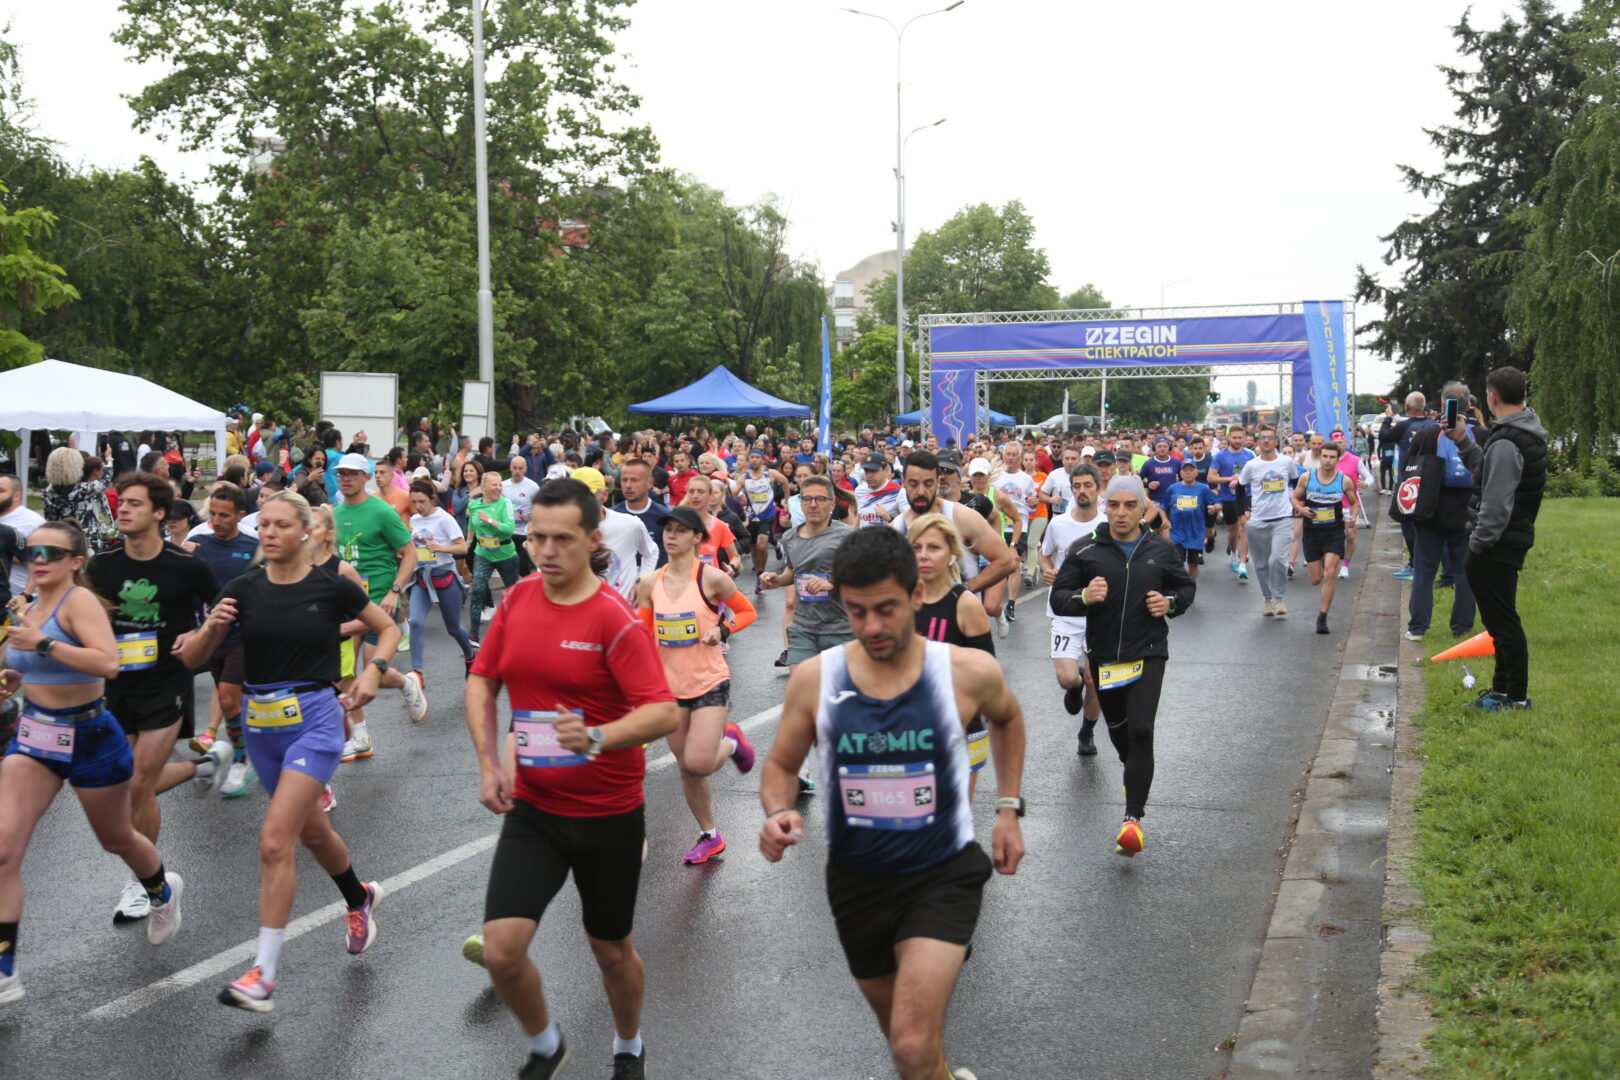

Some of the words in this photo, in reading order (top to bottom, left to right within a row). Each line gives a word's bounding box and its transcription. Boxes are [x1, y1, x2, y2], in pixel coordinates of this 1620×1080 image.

[1104, 325, 1177, 345] ZEGIN
[1085, 345, 1177, 359] СПЕКТРАТОН
[1054, 634, 1071, 652] 97
[837, 729, 935, 754] ATOMIC
[871, 791, 907, 805] 1165
